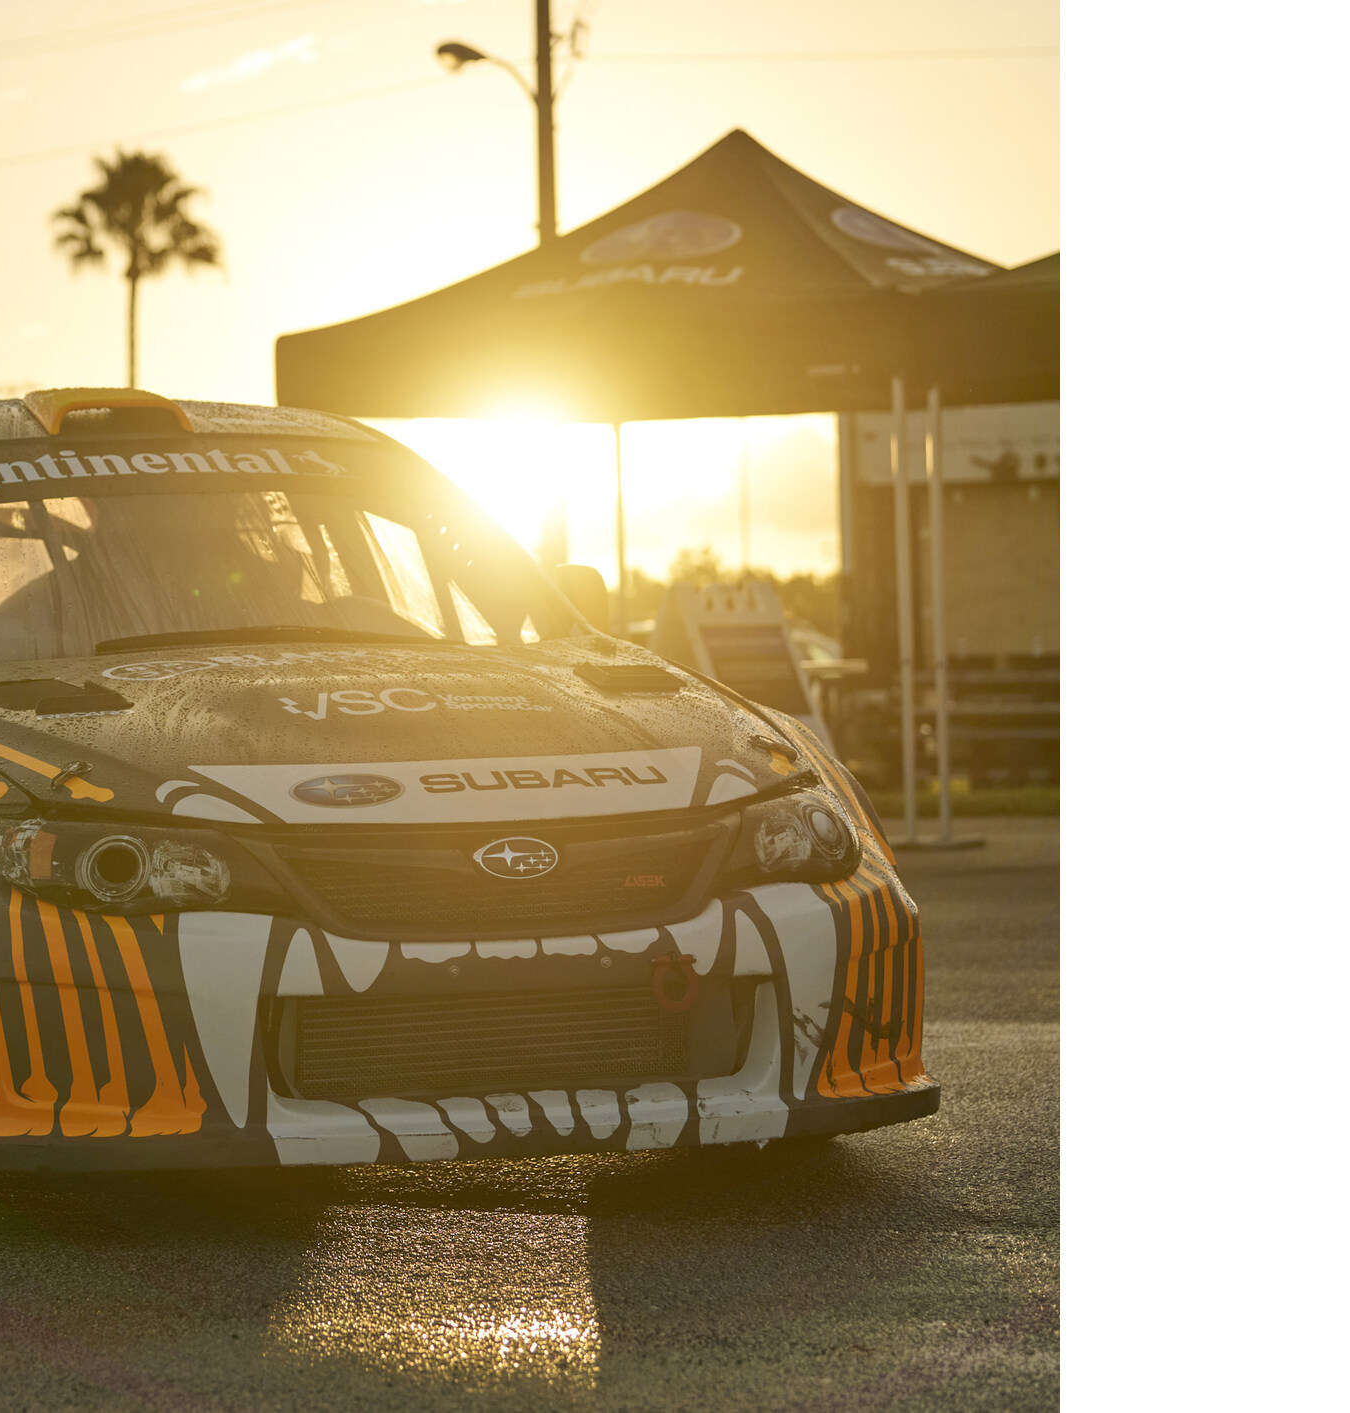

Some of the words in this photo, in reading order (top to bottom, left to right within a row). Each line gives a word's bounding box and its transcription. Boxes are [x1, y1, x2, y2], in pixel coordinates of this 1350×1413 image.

[278, 687, 436, 720] VSC
[419, 764, 668, 793] SUBARU
[624, 874, 665, 888] LASEK
